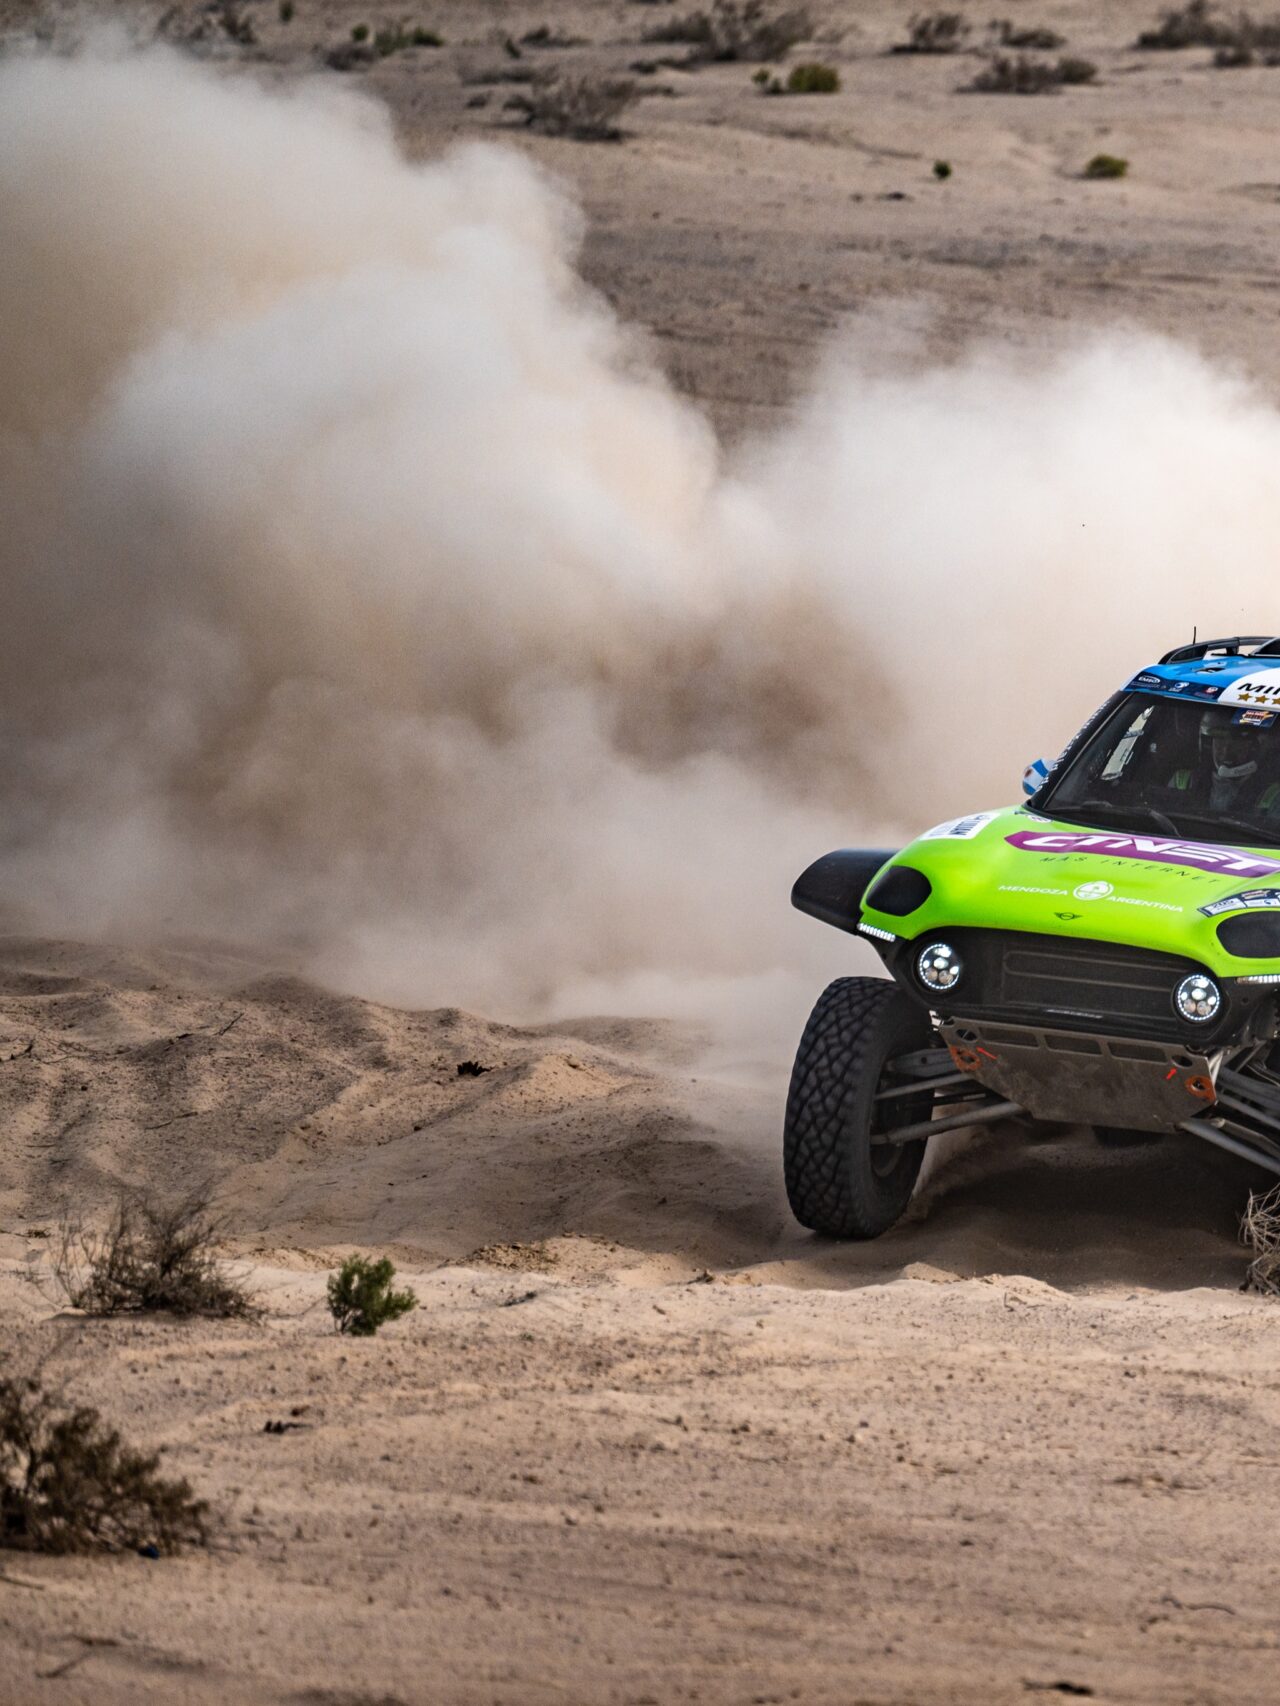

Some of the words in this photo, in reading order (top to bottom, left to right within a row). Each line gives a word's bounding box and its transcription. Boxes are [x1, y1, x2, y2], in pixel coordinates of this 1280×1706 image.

[1100, 858, 1221, 884] INTERNET
[998, 885, 1068, 896] MENDOZA
[1106, 895, 1184, 913] ARGENTINA
